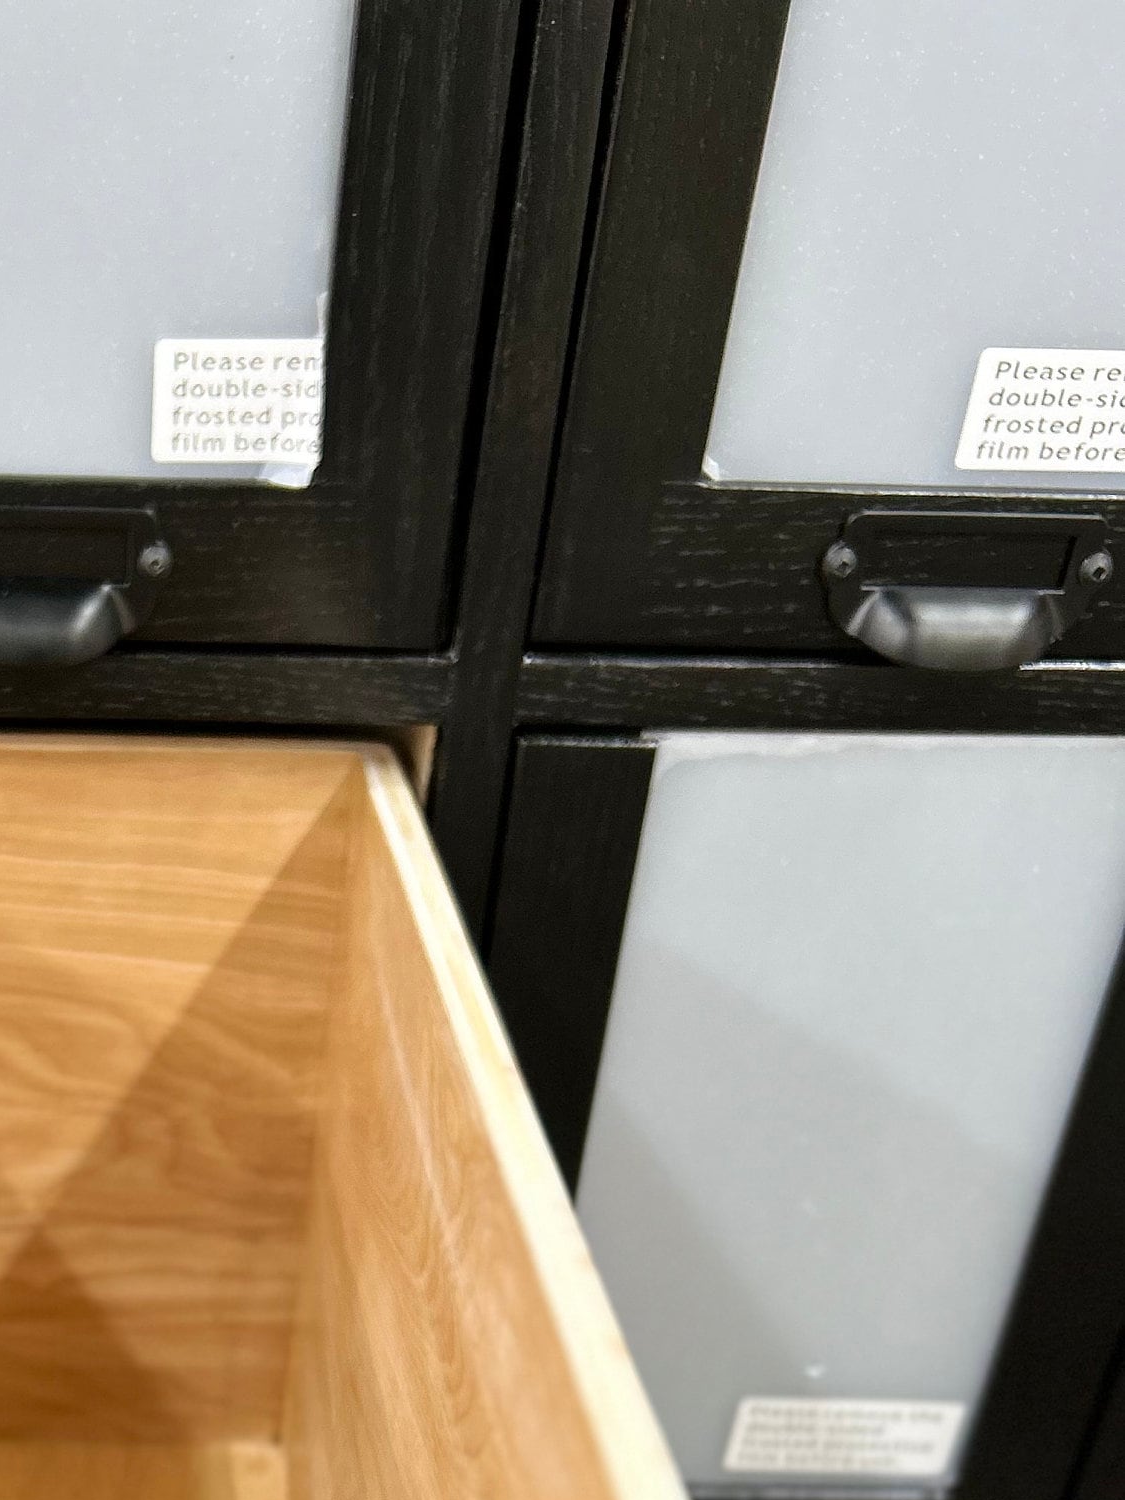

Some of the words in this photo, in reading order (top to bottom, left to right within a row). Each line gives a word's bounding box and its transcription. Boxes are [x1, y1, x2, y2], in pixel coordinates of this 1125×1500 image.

[173, 351, 265, 371] Please
[995, 360, 1085, 381] Please
[1093, 366, 1125, 381] re
[172, 406, 272, 425] frosted
[983, 413, 1083, 434] frosted
[172, 433, 224, 452] film
[234, 433, 321, 453] before
[977, 440, 1030, 460] film
[1039, 442, 1125, 461] before
